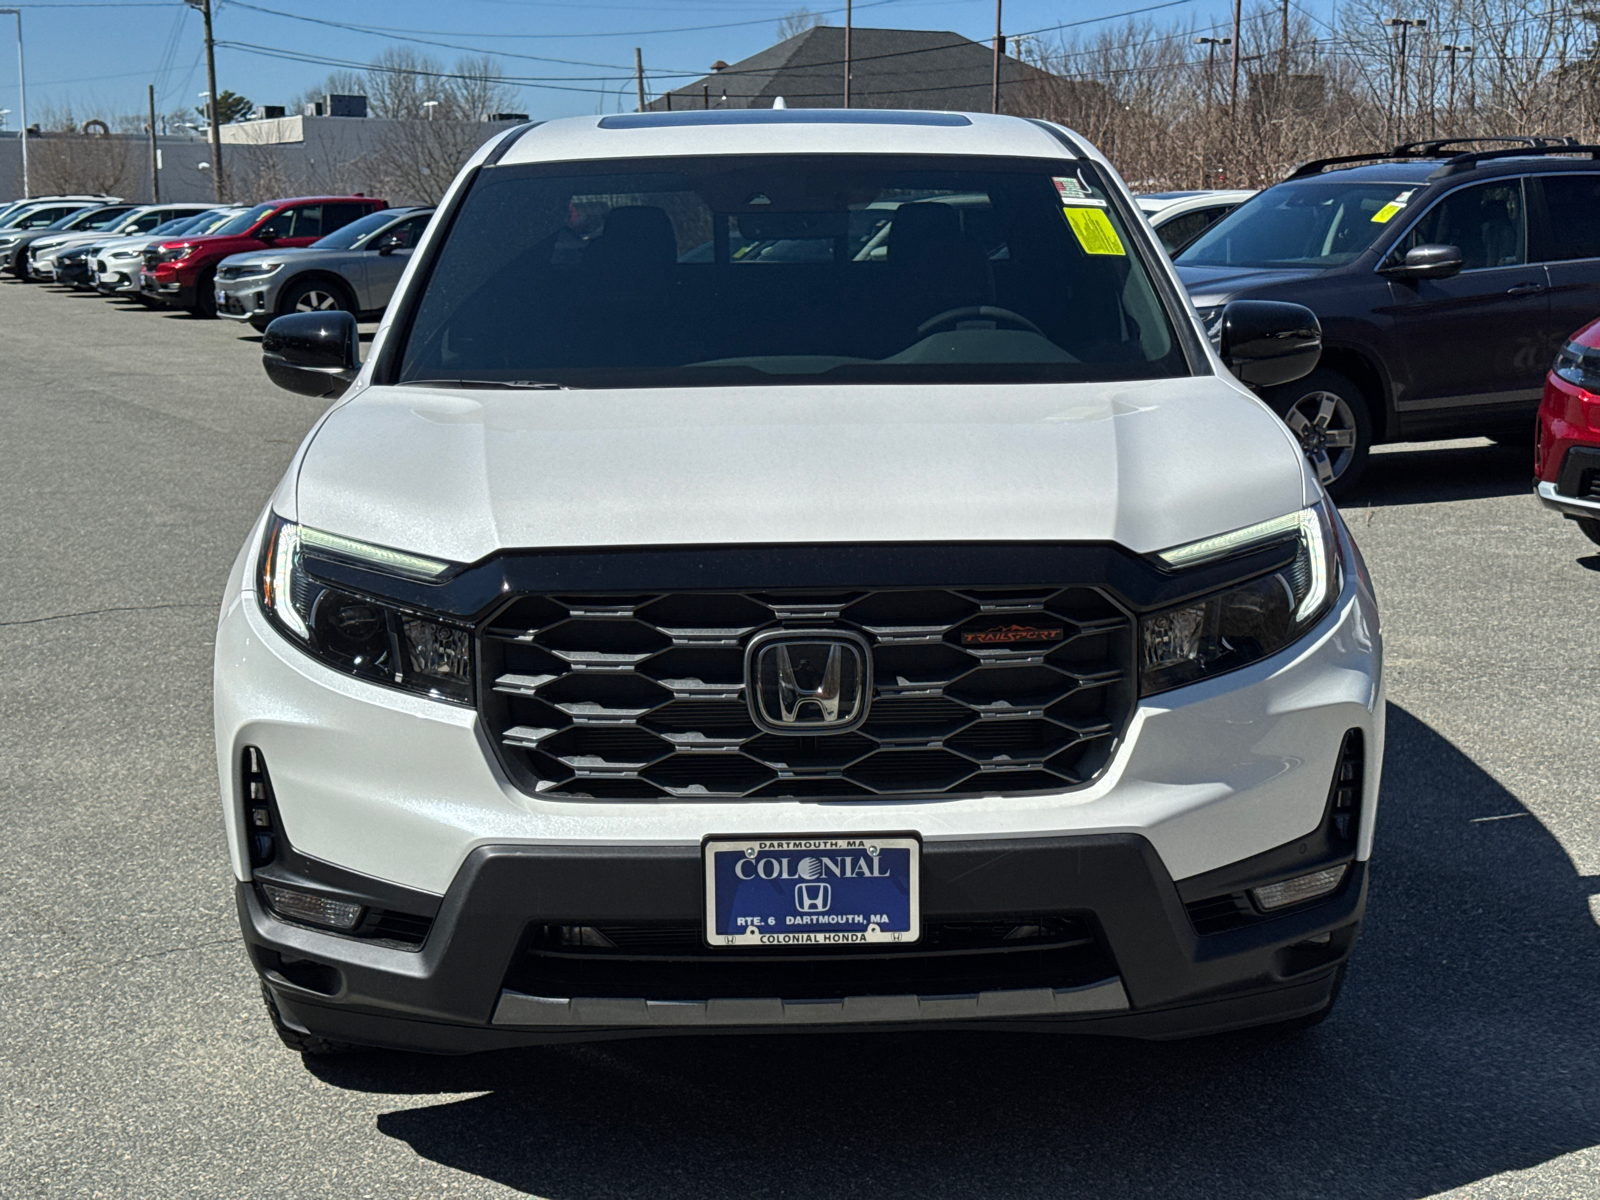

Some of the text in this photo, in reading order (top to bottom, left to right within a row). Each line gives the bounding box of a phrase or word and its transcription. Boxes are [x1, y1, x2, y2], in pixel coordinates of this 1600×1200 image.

[964, 630, 1060, 642] TRAILSPORT
[846, 840, 866, 848] MA
[734, 856, 890, 880] COLONIAL
[737, 914, 890, 926] RTE. 6 DARTMOUTH, MA
[759, 933, 867, 944] COLONIAL HONDA
